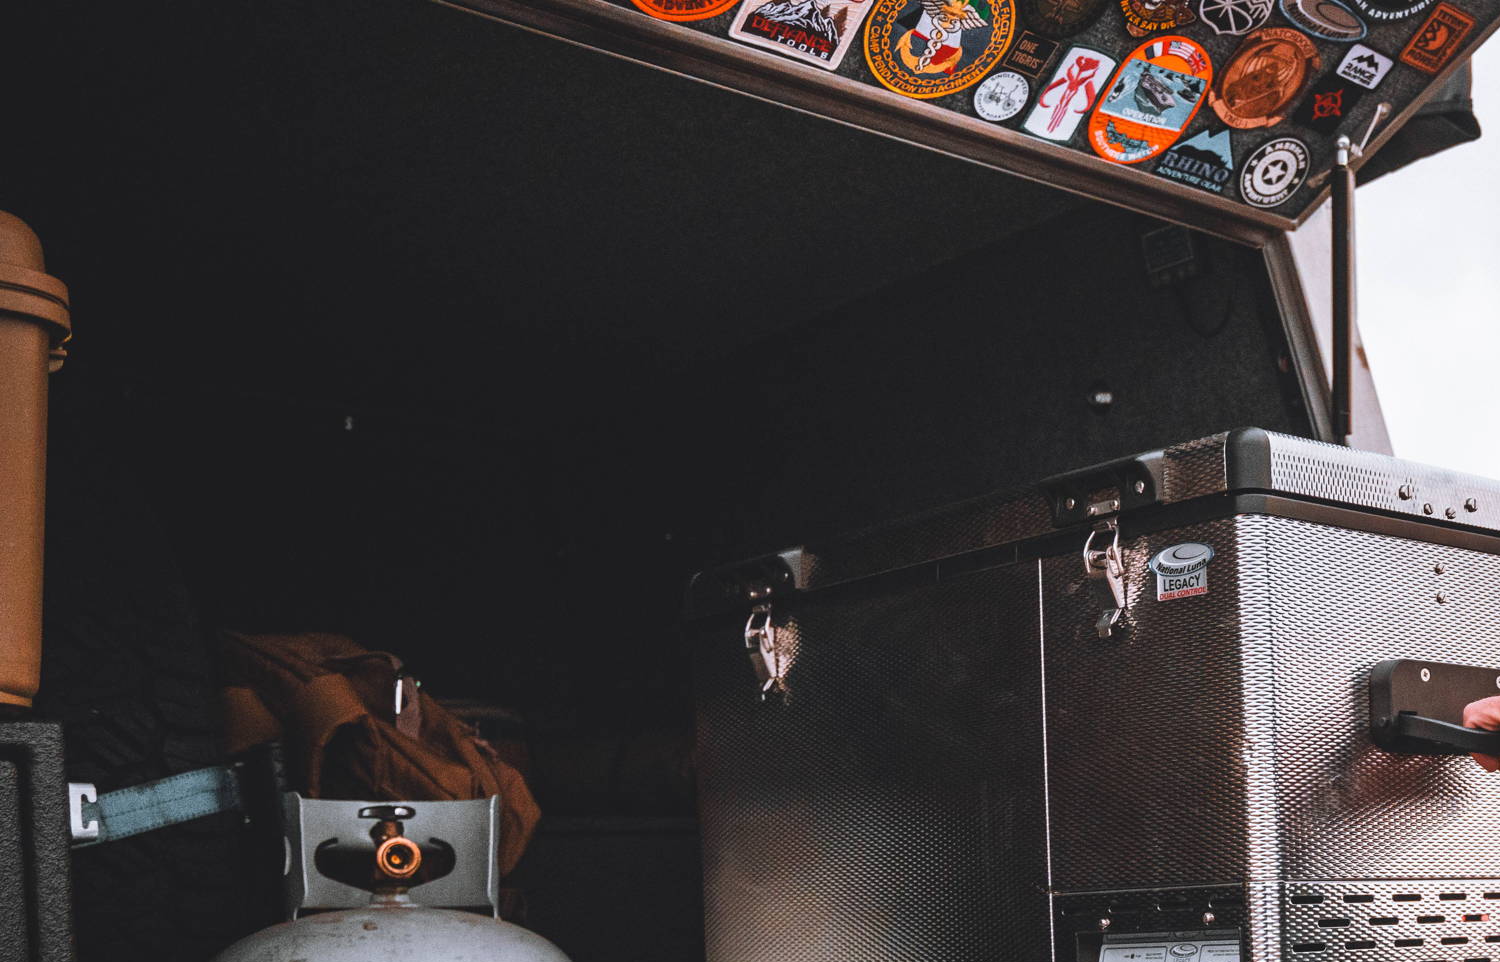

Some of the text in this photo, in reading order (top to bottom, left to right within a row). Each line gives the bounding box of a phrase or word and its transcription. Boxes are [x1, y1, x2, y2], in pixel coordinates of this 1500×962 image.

[752, 15, 833, 53] DEFIANCE
[1019, 40, 1039, 54] ONE
[870, 25, 986, 94] CAMP PENDLETON DETACHMENT
[1012, 51, 1040, 69] TIGRIS
[1161, 151, 1229, 183] RHINO
[1156, 558, 1207, 575] National Luna
[1163, 573, 1201, 592] LEGACY
[1176, 586, 1206, 597] CONTROL
